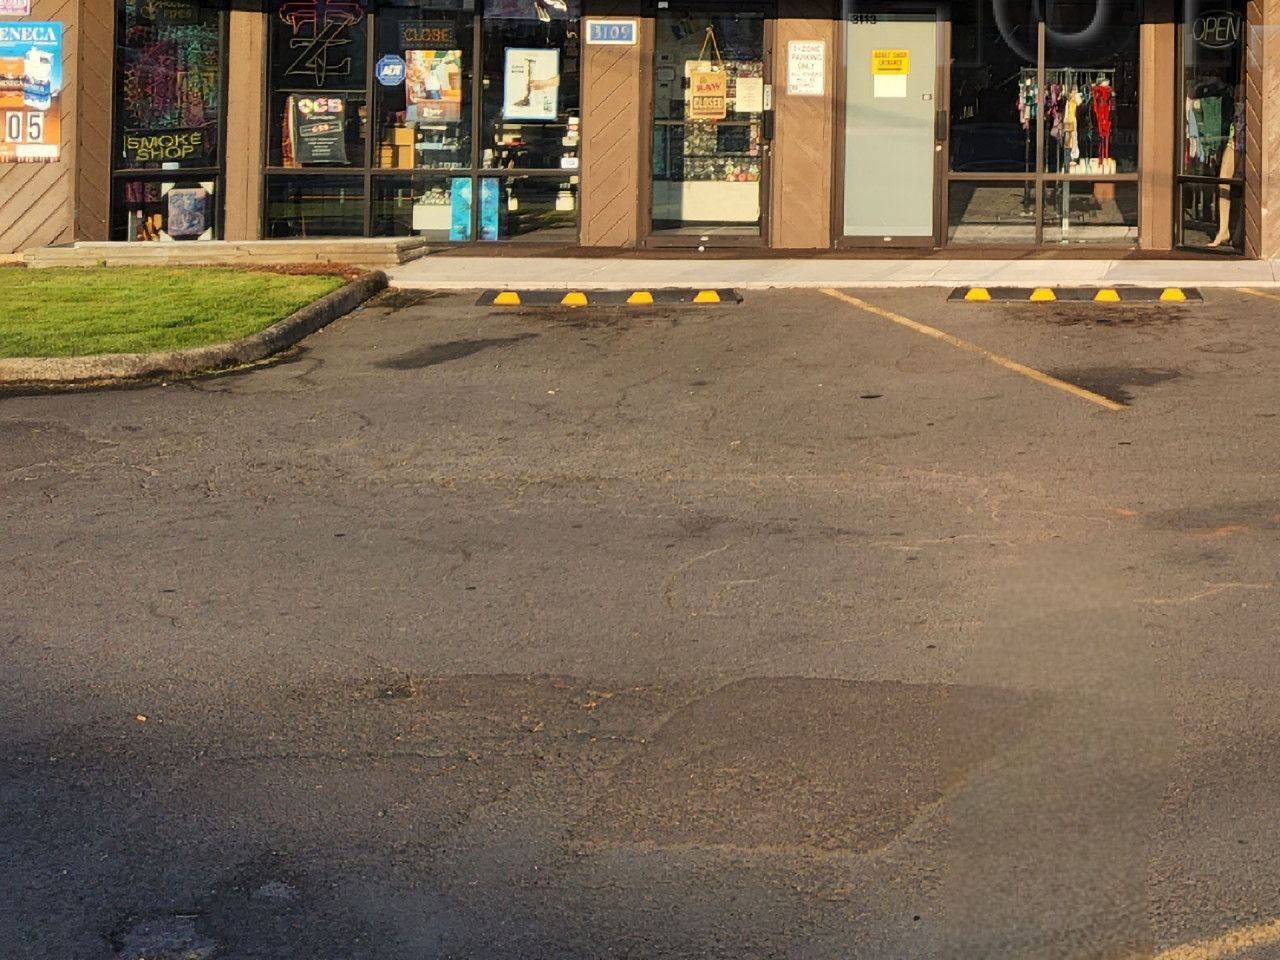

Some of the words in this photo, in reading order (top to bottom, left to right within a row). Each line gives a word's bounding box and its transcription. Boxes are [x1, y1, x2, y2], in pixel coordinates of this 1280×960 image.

[851, 14, 877, 25] 3113
[0, 27, 57, 41] ENECA
[404, 27, 449, 41] CLOSE
[594, 24, 631, 40] 3109
[1192, 16, 1241, 41] OPEN
[695, 82, 723, 92] RAW
[298, 98, 344, 114] OCB
[692, 97, 724, 109] CLOSED
[127, 131, 202, 150] SMOKE
[136, 145, 195, 161] SHOP
